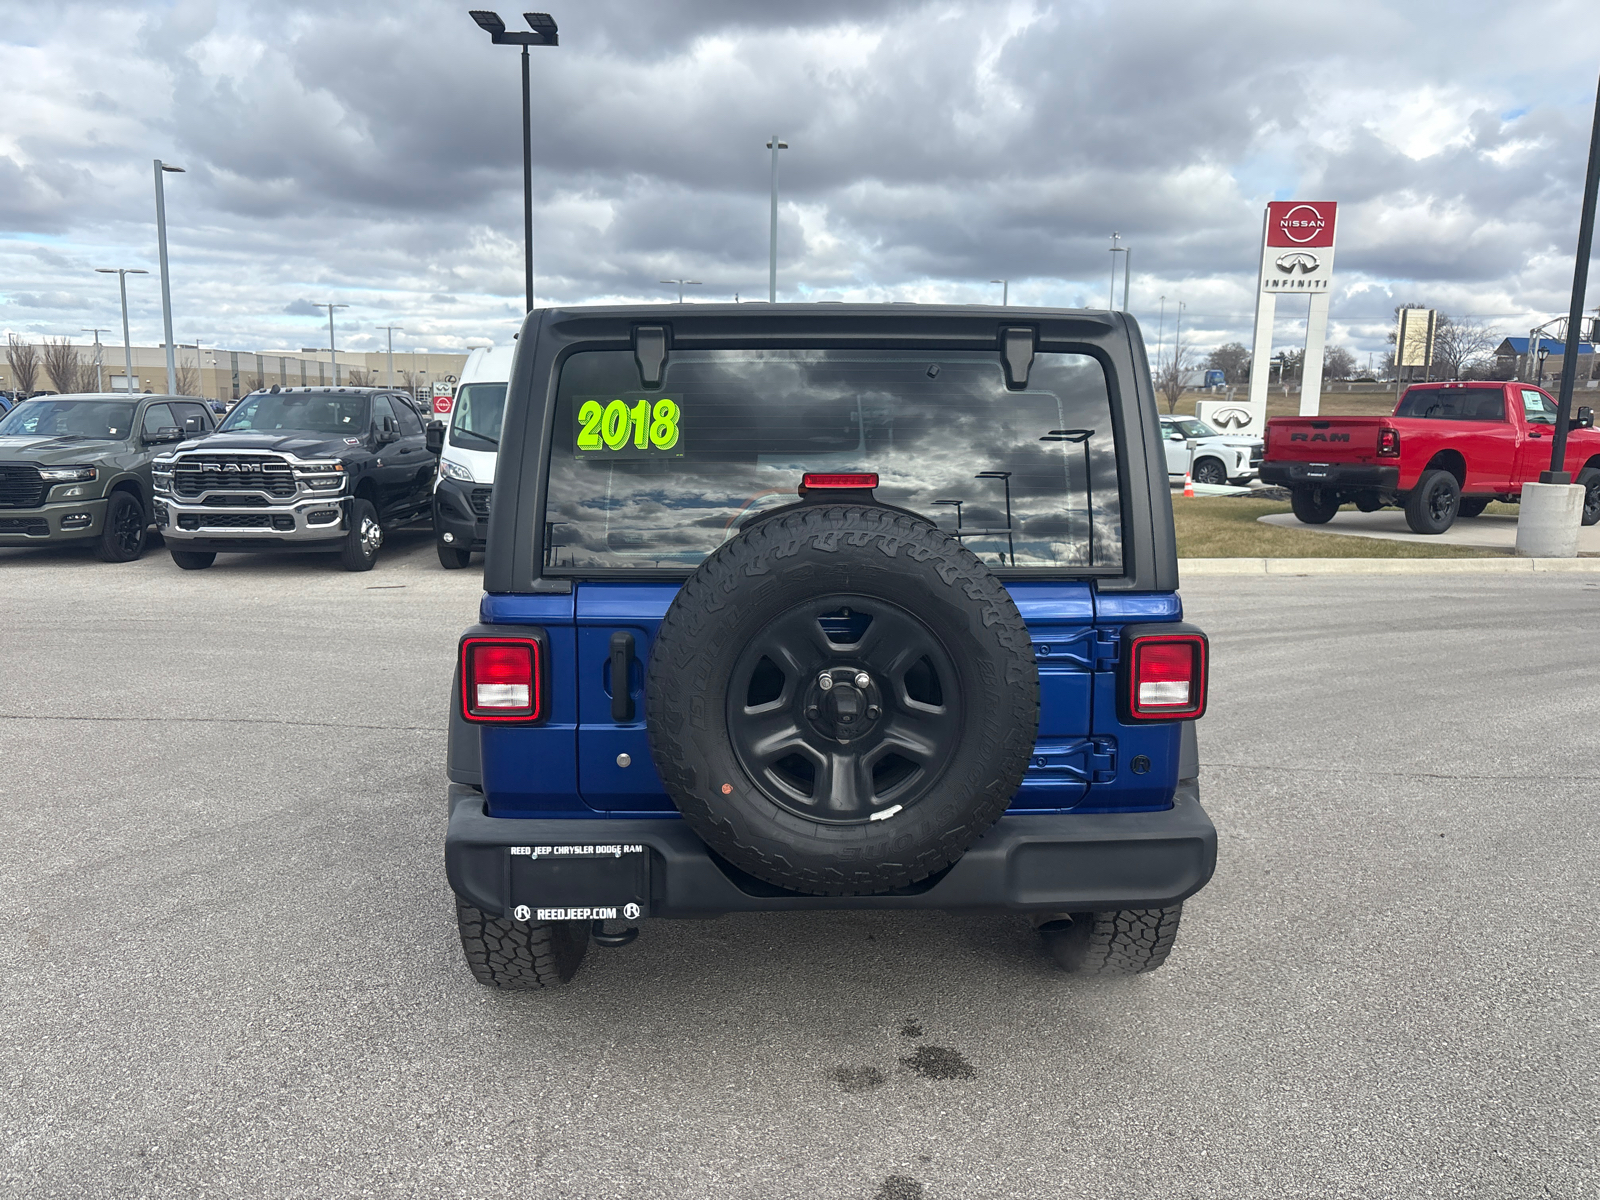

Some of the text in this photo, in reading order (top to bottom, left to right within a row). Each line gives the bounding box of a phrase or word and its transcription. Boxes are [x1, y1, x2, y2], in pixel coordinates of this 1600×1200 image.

[1280, 220, 1325, 228] NISSAN
[1265, 279, 1327, 288] INFINITI
[577, 399, 680, 451] 2018
[1290, 433, 1350, 442] RAM
[202, 463, 260, 473] RAM
[837, 655, 1000, 862] BRIDGESTONE
[510, 844, 643, 855] REED JEEP CHRYSLER DODGE RAM
[537, 908, 616, 920] REEDJEEP.COM
